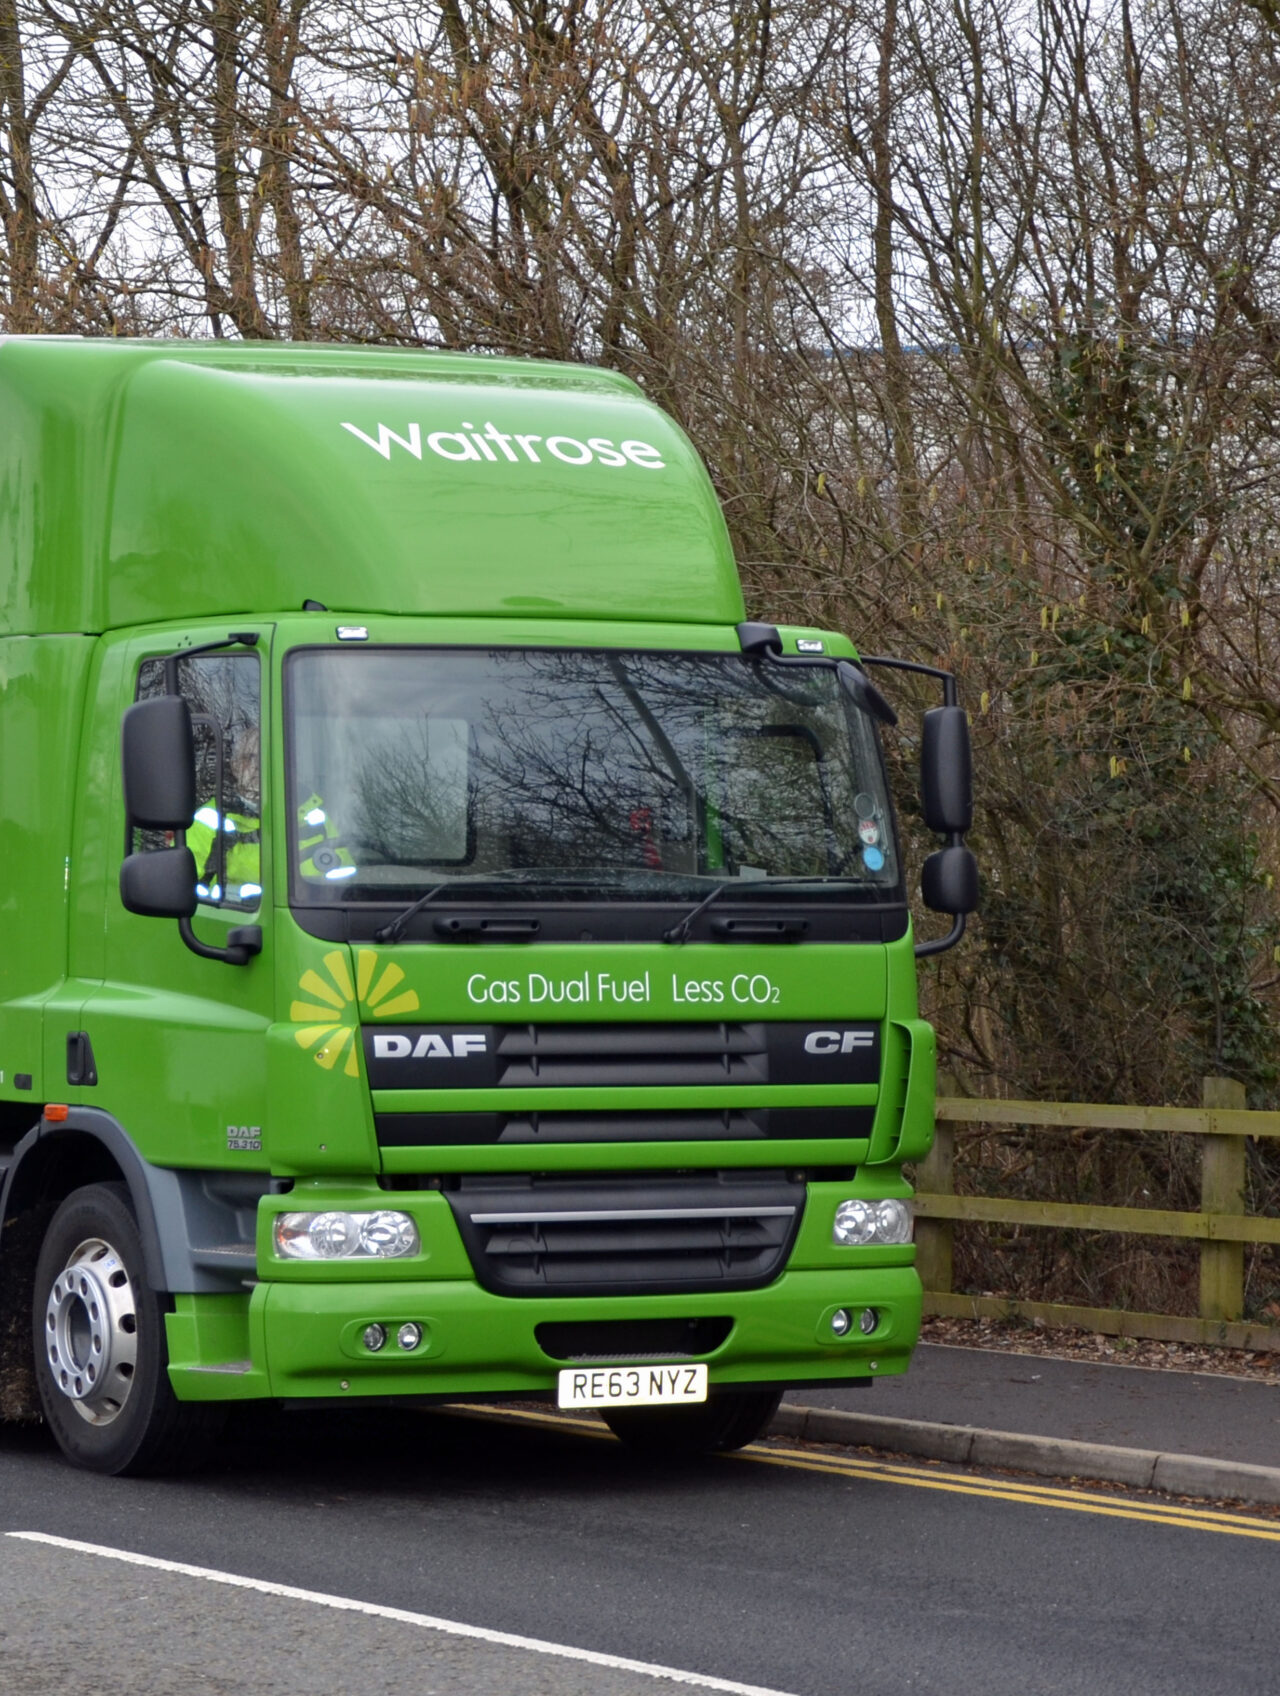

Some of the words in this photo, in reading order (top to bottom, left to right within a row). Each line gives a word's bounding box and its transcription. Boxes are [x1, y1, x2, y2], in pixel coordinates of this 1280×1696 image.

[340, 420, 666, 470] Waitrose
[467, 974, 521, 1003] Gas
[528, 971, 590, 1003] Dual
[597, 971, 651, 1003] Fuel
[672, 973, 724, 1003] Less
[372, 1033, 487, 1058] DAF
[803, 1031, 875, 1054] CF
[227, 1125, 262, 1138] DAF
[573, 1371, 640, 1399] RE63
[649, 1369, 697, 1396] NYZ
